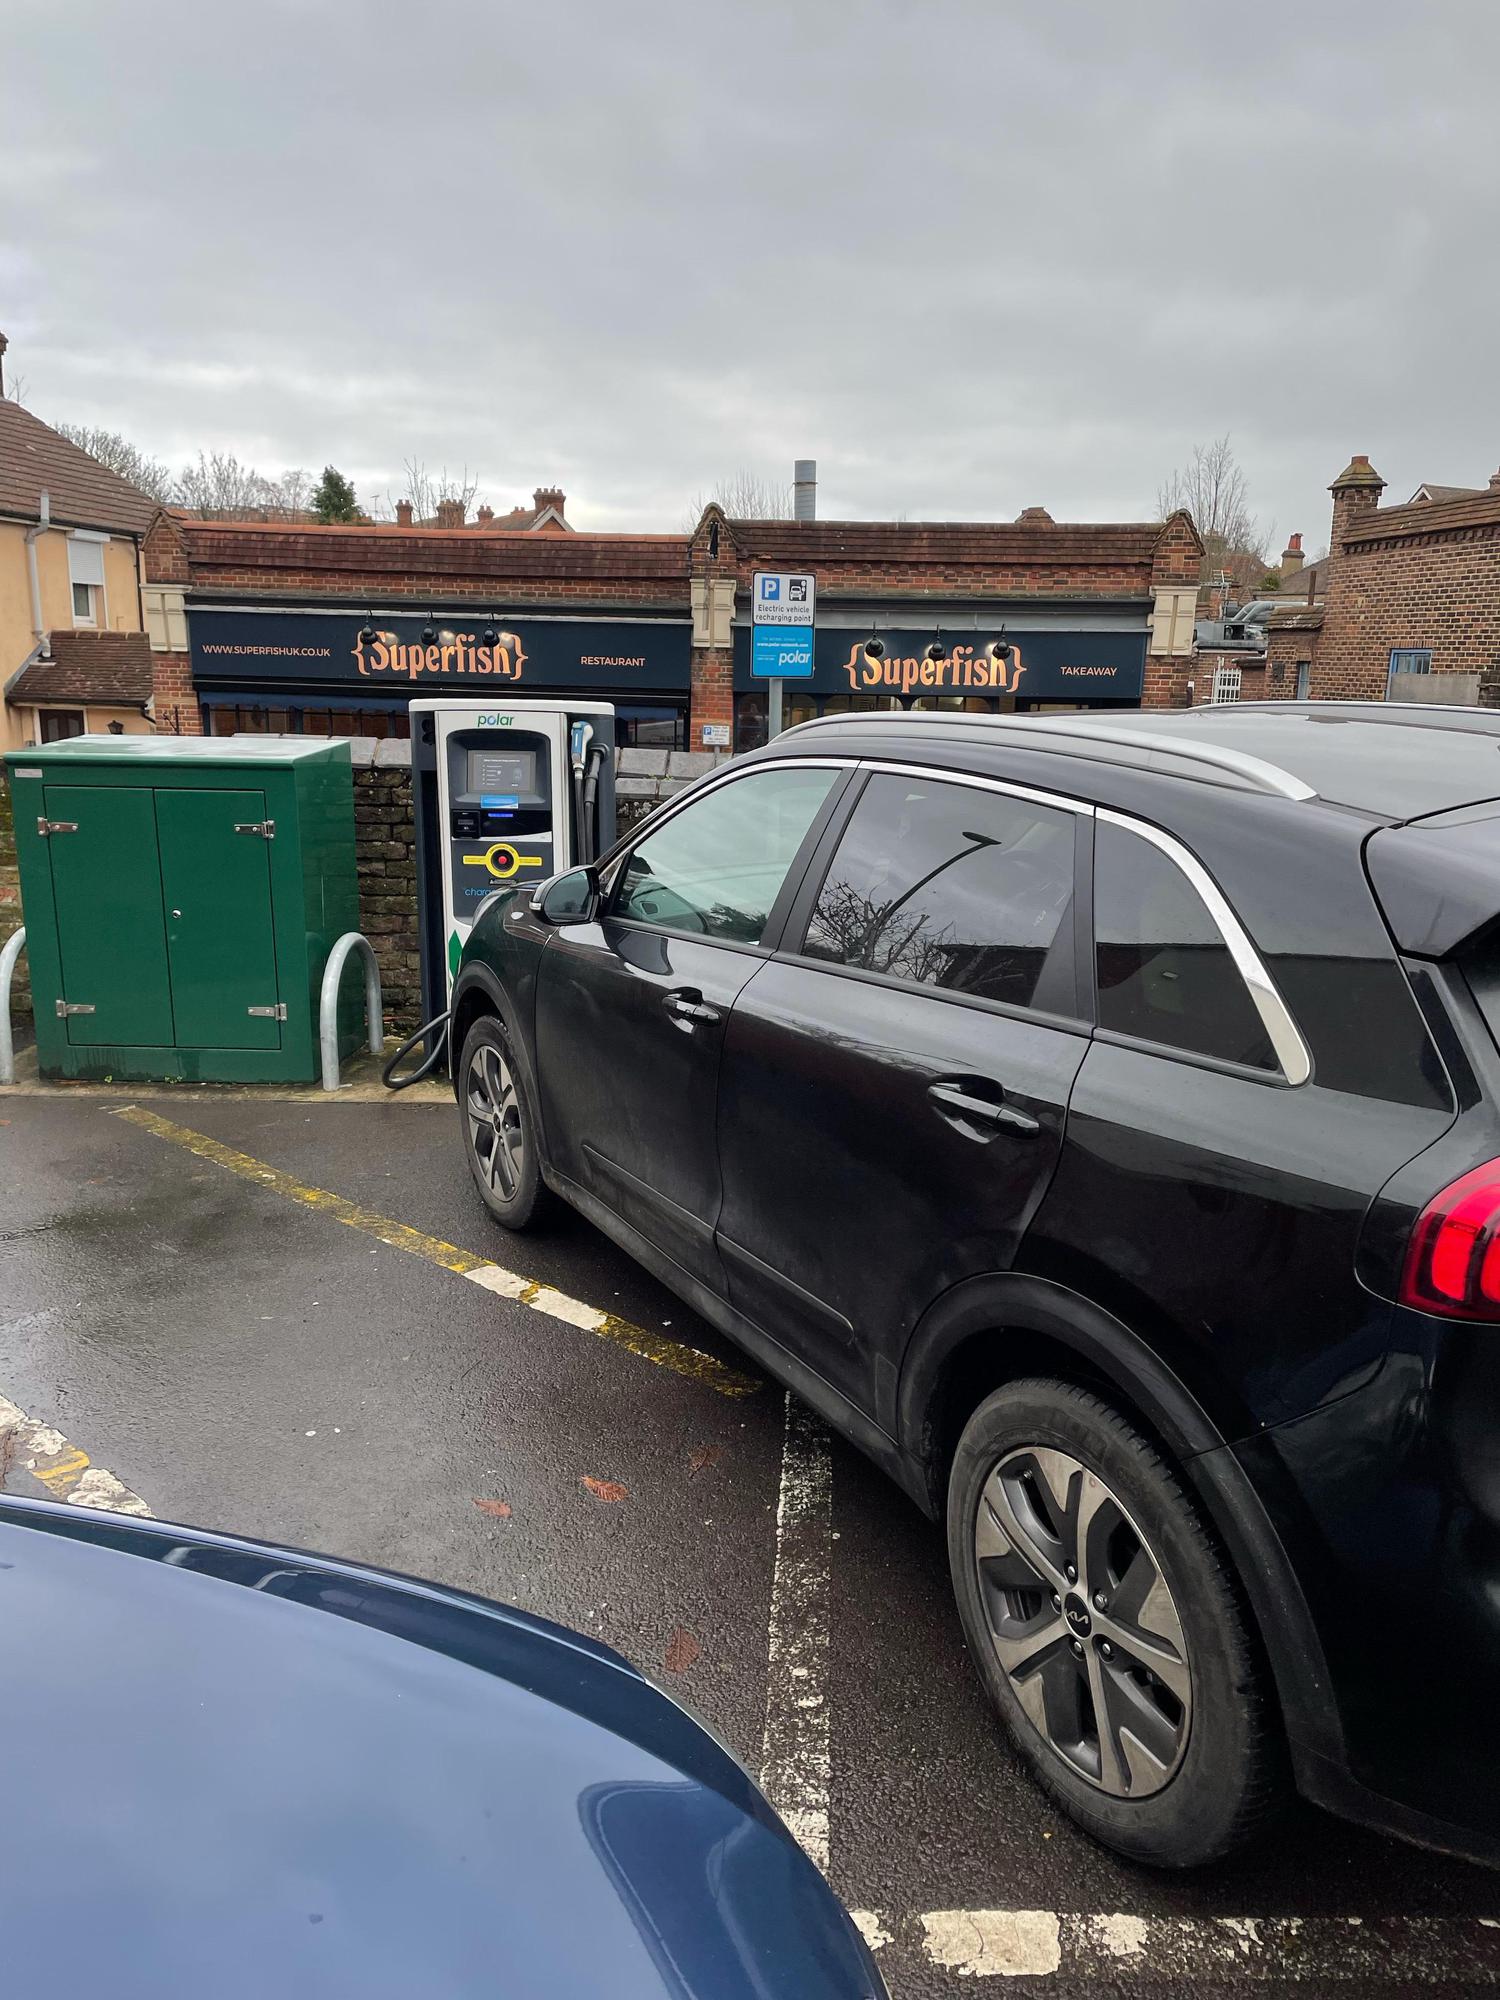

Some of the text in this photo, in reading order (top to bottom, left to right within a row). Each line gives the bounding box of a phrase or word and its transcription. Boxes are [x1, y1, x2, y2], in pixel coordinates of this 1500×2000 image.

[758, 604, 784, 612] Electric
[755, 614, 792, 622] recharging
[202, 644, 331, 657] WWW.SUPERFISHUK.CO.UK
[580, 656, 646, 667] RESTAURANT
[778, 649, 811, 666] polar
[1060, 666, 1118, 676] TAKEAWAY
[477, 712, 514, 727] polar
